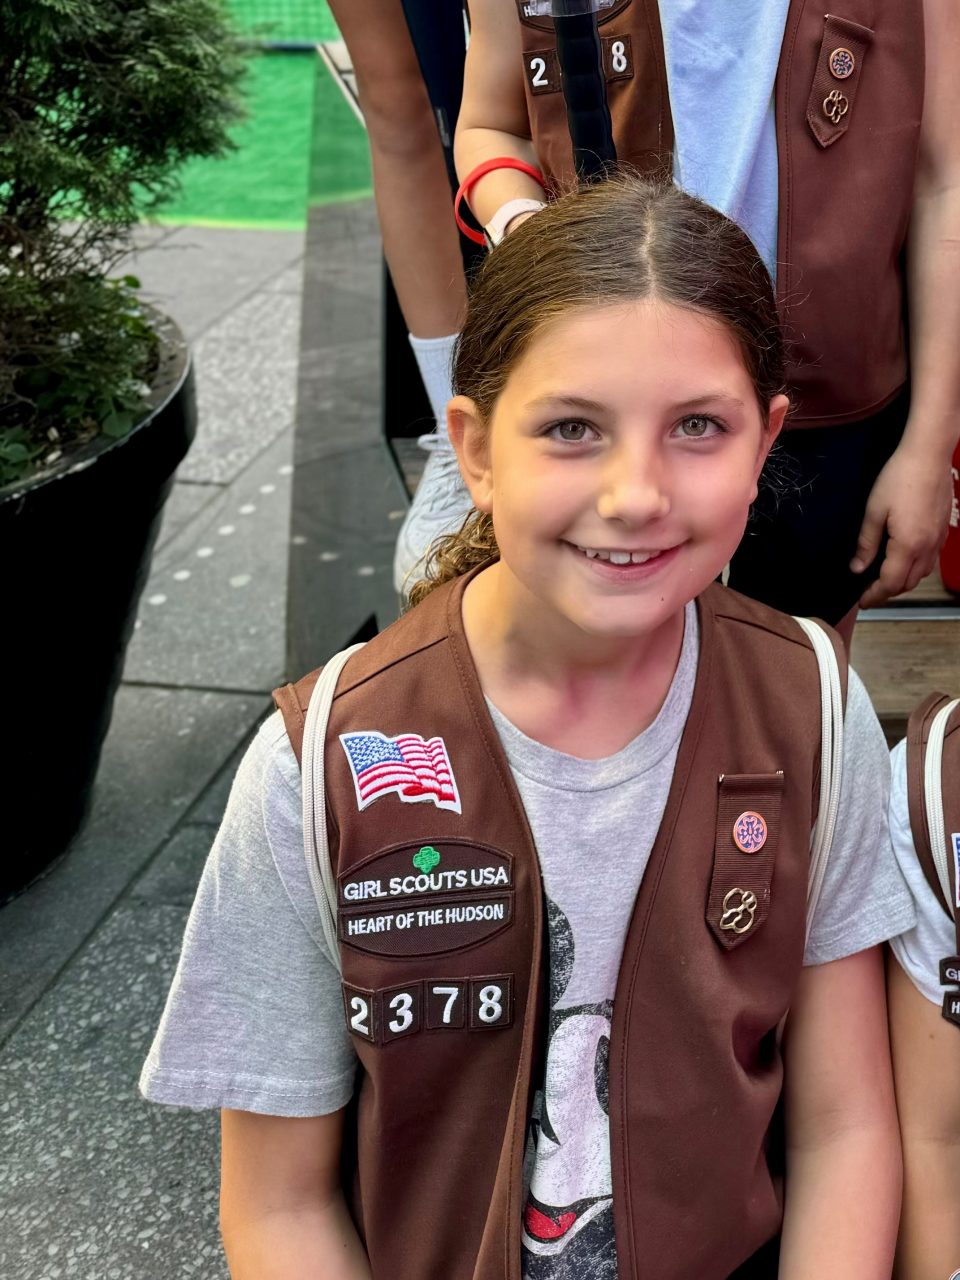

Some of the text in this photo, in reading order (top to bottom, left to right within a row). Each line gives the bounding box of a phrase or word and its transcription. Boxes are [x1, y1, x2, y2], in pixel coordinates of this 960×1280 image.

[344, 866, 509, 900] GIRL SCOUTS USA
[347, 904, 504, 936] HEART OF THE HUDSON
[350, 985, 503, 1036] 2378
